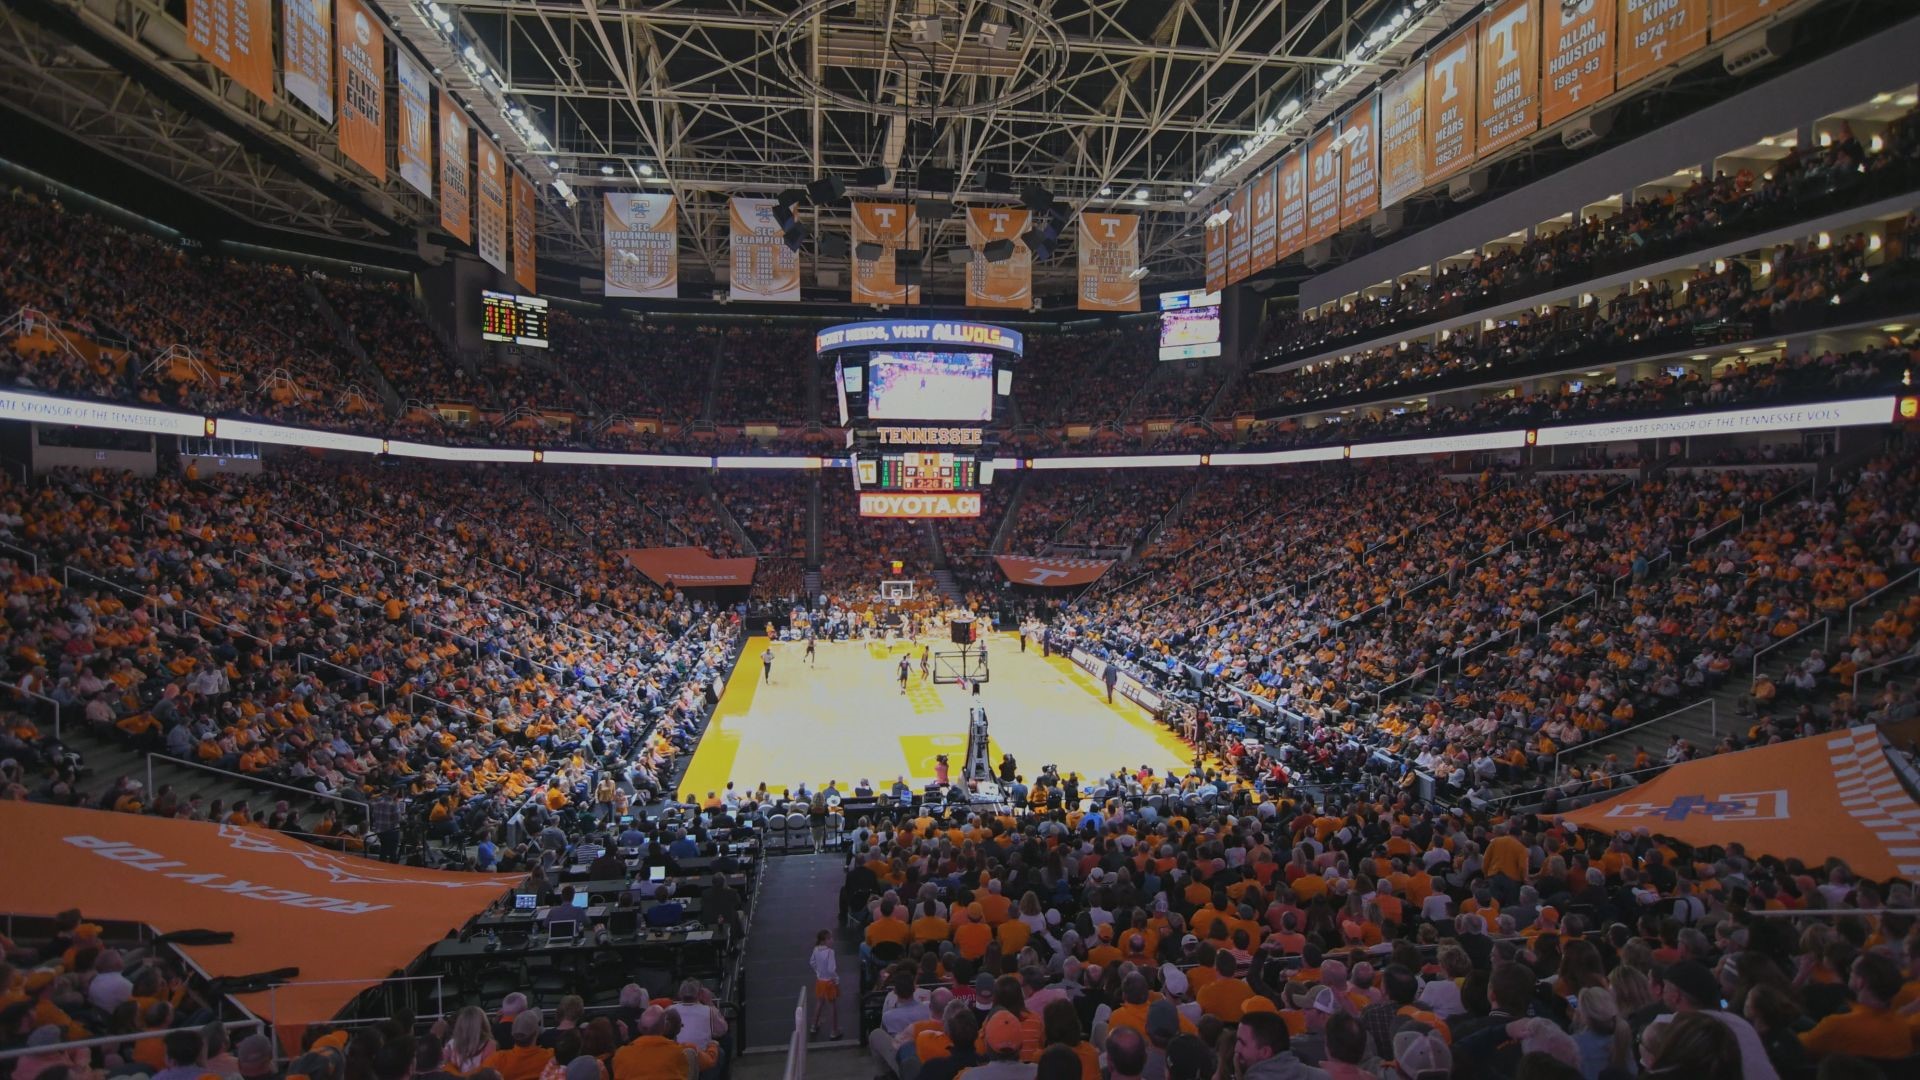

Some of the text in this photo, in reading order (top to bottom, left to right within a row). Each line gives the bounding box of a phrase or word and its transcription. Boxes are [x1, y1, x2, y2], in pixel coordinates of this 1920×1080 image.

[1489, 2, 1528, 68] T
[1559, 18, 1596, 52] ALLAN
[1635, 10, 1686, 48] 1974-77
[1549, 31, 1606, 75] HOUSTON
[1651, 40, 1667, 61] T
[342, 45, 381, 90] BASKETBALL
[1434, 44, 1467, 104] T
[1554, 57, 1600, 91] 1989-93
[347, 67, 378, 108] ELITE
[1494, 68, 1520, 94] JOHN
[345, 84, 381, 126] EIGHT
[1395, 100, 1410, 118] PAT
[1493, 85, 1520, 110] WARD
[1384, 107, 1422, 140] SUMMITT
[1441, 105, 1457, 125] RAY
[1490, 111, 1524, 138] 1964-99
[1436, 118, 1463, 144] MEARS
[446, 160, 464, 184] SWEET
[1315, 150, 1332, 182] 30
[1350, 158, 1368, 178] HOLLY
[444, 169, 467, 198] SIXTEEN
[1285, 171, 1299, 200] 32
[874, 207, 897, 228] T
[1257, 191, 1271, 219] 23
[631, 223, 650, 232] SEC
[756, 227, 774, 236] SEC
[989, 213, 1010, 233] T
[1101, 218, 1120, 237] T
[1233, 206, 1245, 233] 24
[609, 231, 672, 240] TOURNAMENT
[610, 240, 671, 249] CHAMPIONS
[735, 235, 784, 245] CHAMPIO
[893, 326, 930, 338] VISIT
[22, 402, 71, 416] SPONSOR
[75, 408, 88, 417] OF
[92, 409, 108, 420] THE
[112, 412, 157, 426] TENNESSEE
[1600, 425, 1648, 437] CORPORATE
[1650, 419, 1695, 432] SPONSOR
[1700, 418, 1711, 428] OF
[1716, 416, 1735, 427] THE
[1740, 411, 1801, 425] TENNESSEE
[1807, 408, 1840, 420] VOLS
[877, 427, 983, 444] TENNESSEE
[860, 464, 873, 480] T
[1023, 568, 1069, 585] T
[63, 835, 393, 914] ROCKY TOP
